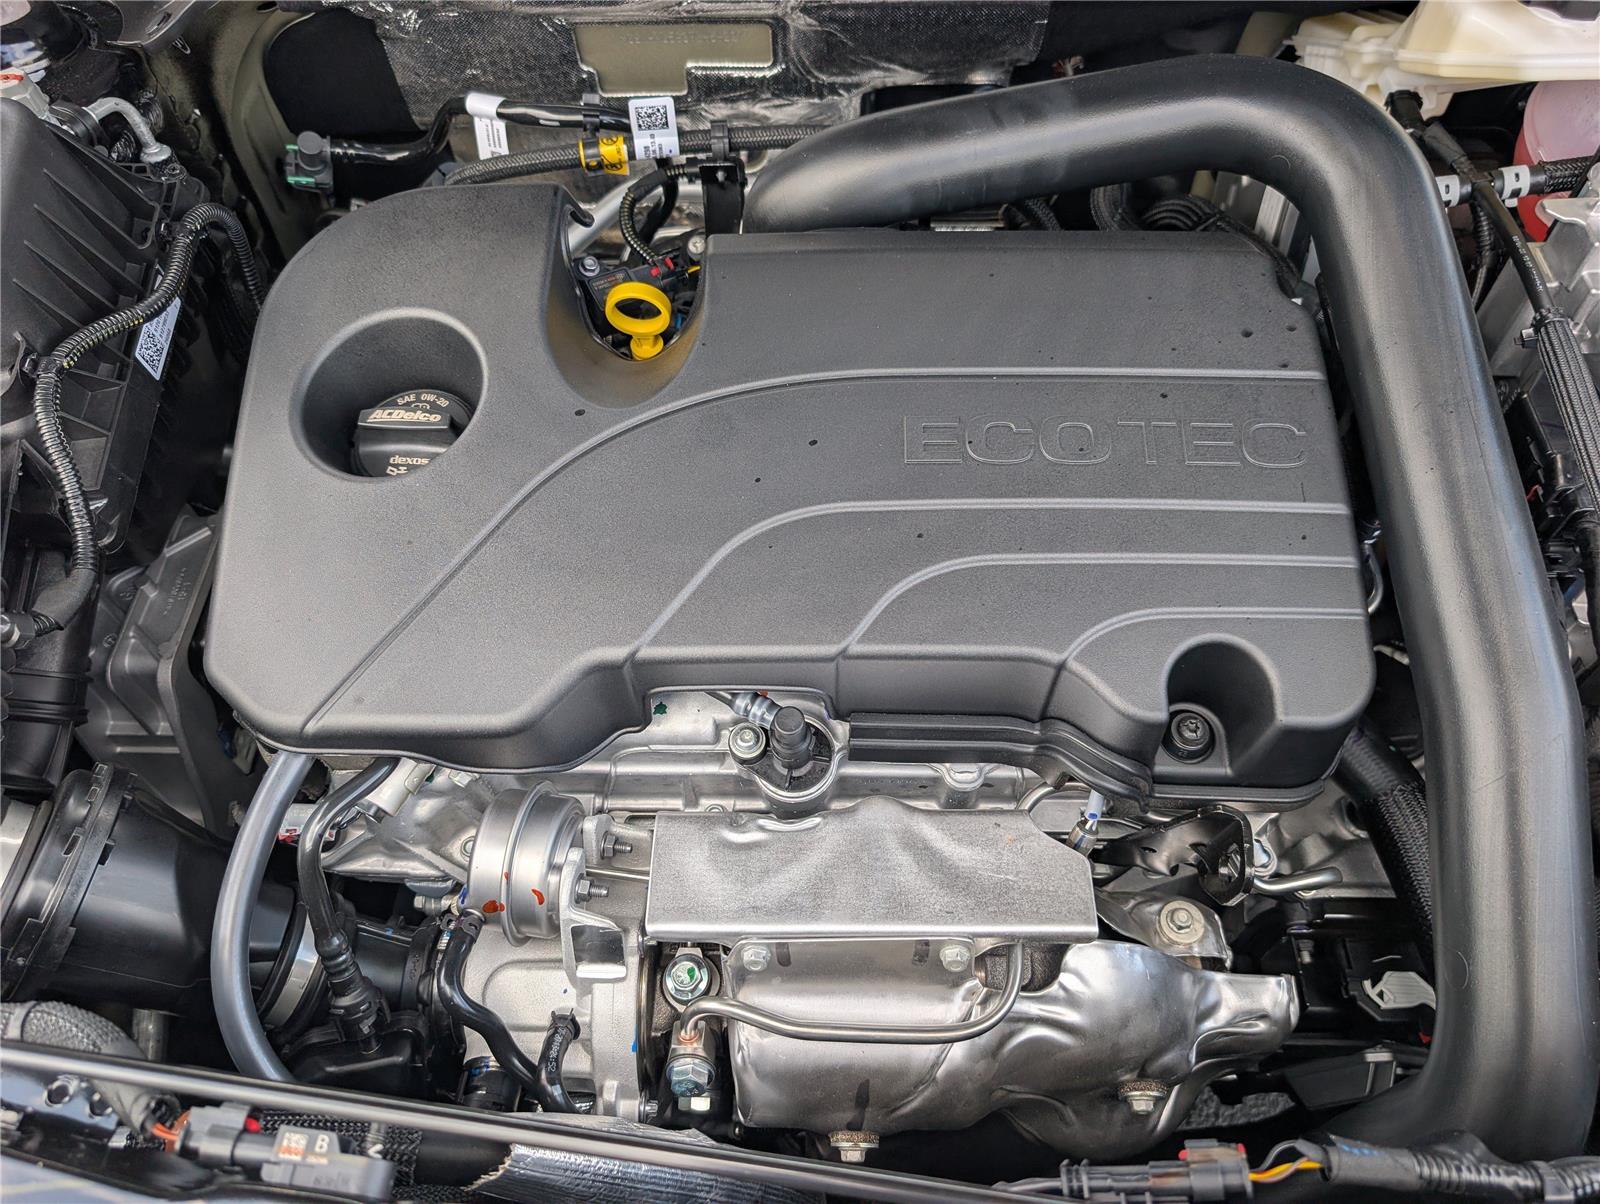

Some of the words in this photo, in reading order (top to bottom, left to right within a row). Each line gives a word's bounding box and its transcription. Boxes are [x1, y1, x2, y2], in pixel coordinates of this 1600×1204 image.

[397, 394, 417, 406] SAE
[421, 393, 450, 407] 0W-20
[366, 409, 442, 422] ACDelco
[903, 415, 1307, 468] ECOTEC
[389, 455, 430, 465] dexos
[313, 1134, 330, 1153] B
